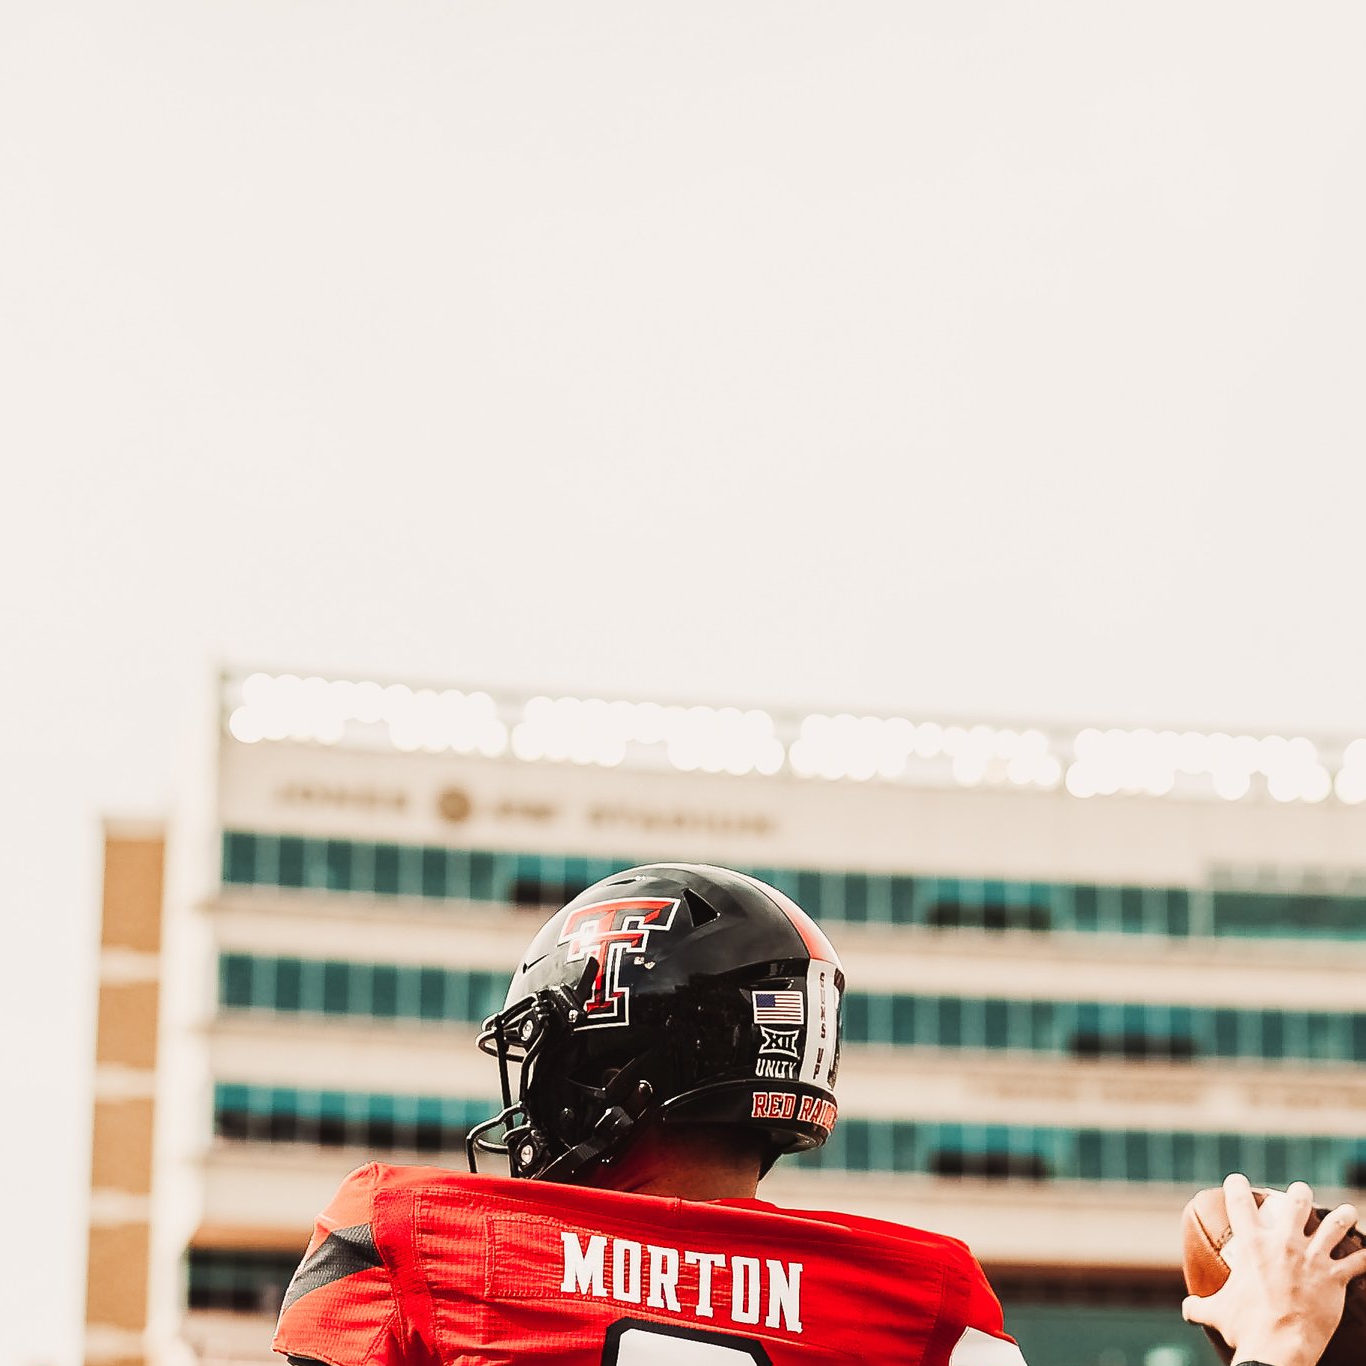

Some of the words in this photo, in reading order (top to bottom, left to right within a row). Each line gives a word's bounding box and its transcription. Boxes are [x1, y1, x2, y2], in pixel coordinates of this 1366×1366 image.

[755, 1059, 797, 1079] UNITY
[813, 1048, 824, 1079] UP
[752, 1092, 796, 1119] RED
[560, 1231, 803, 1334] MORTON
